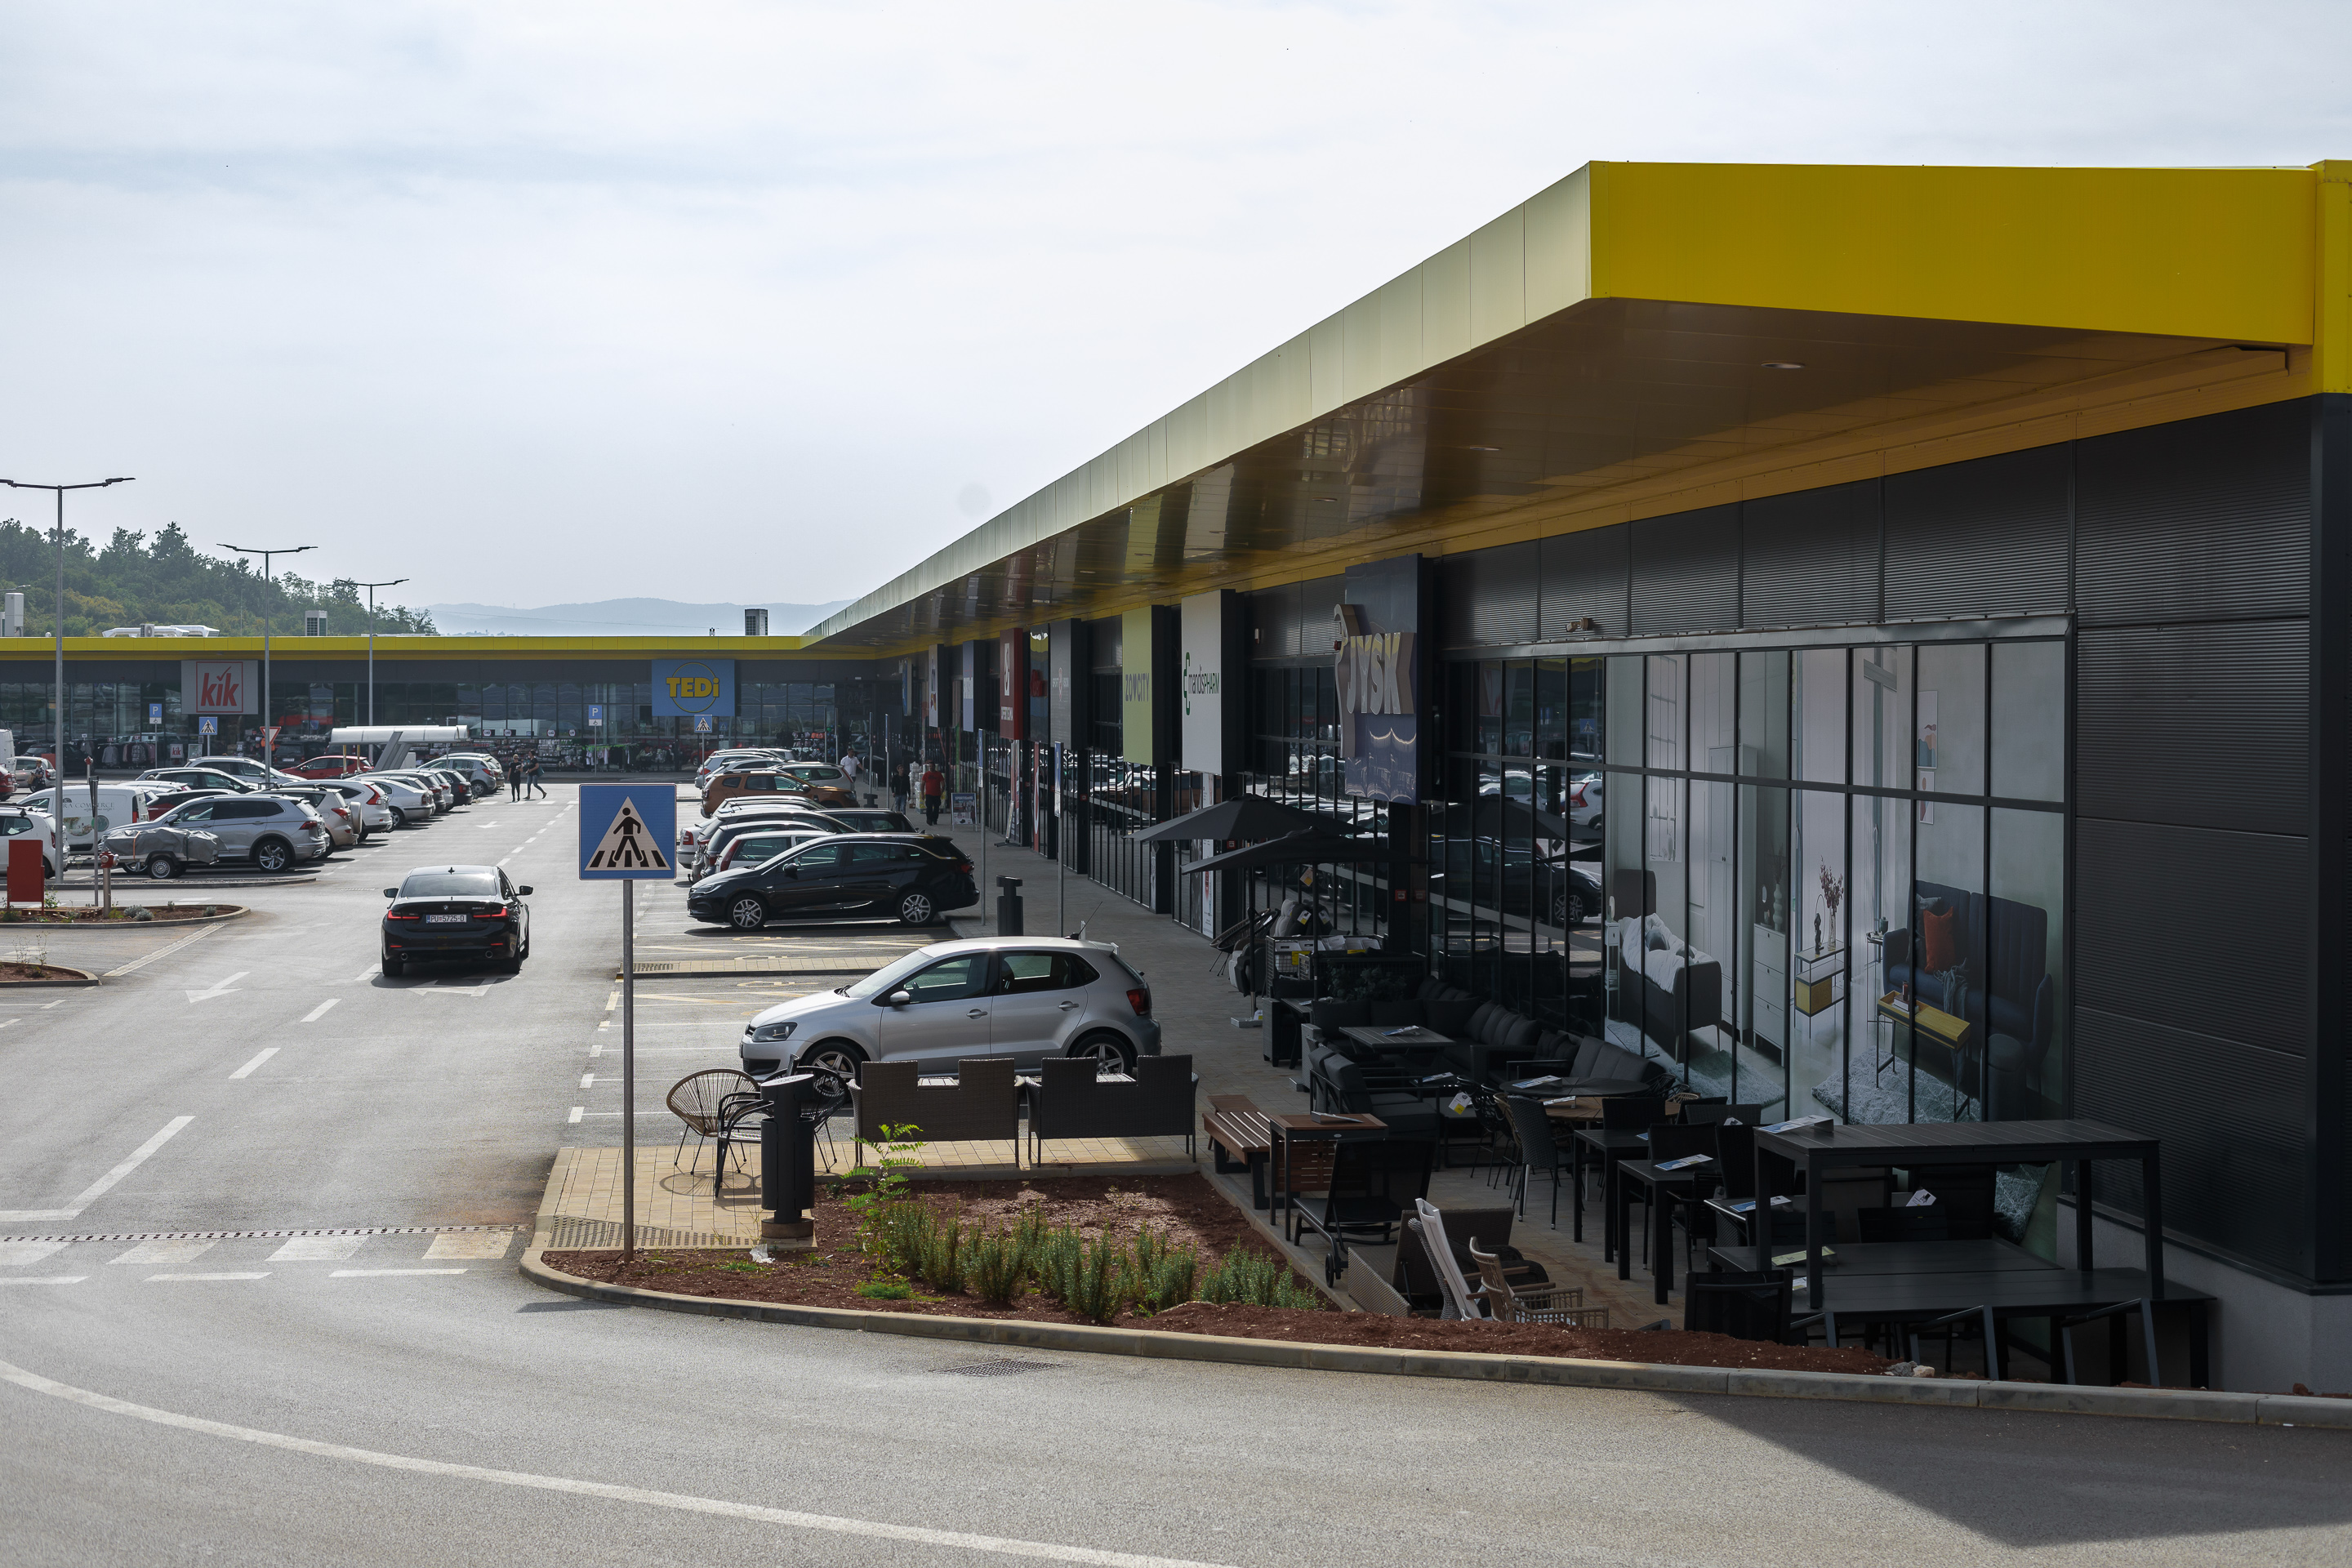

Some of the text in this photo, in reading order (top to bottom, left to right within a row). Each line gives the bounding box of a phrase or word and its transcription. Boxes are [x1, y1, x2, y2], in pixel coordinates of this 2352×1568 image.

[1347, 632, 1401, 715] JYSK
[666, 677, 719, 698] TEDi
[153, 706, 158, 715] P
[592, 708, 599, 716] P
